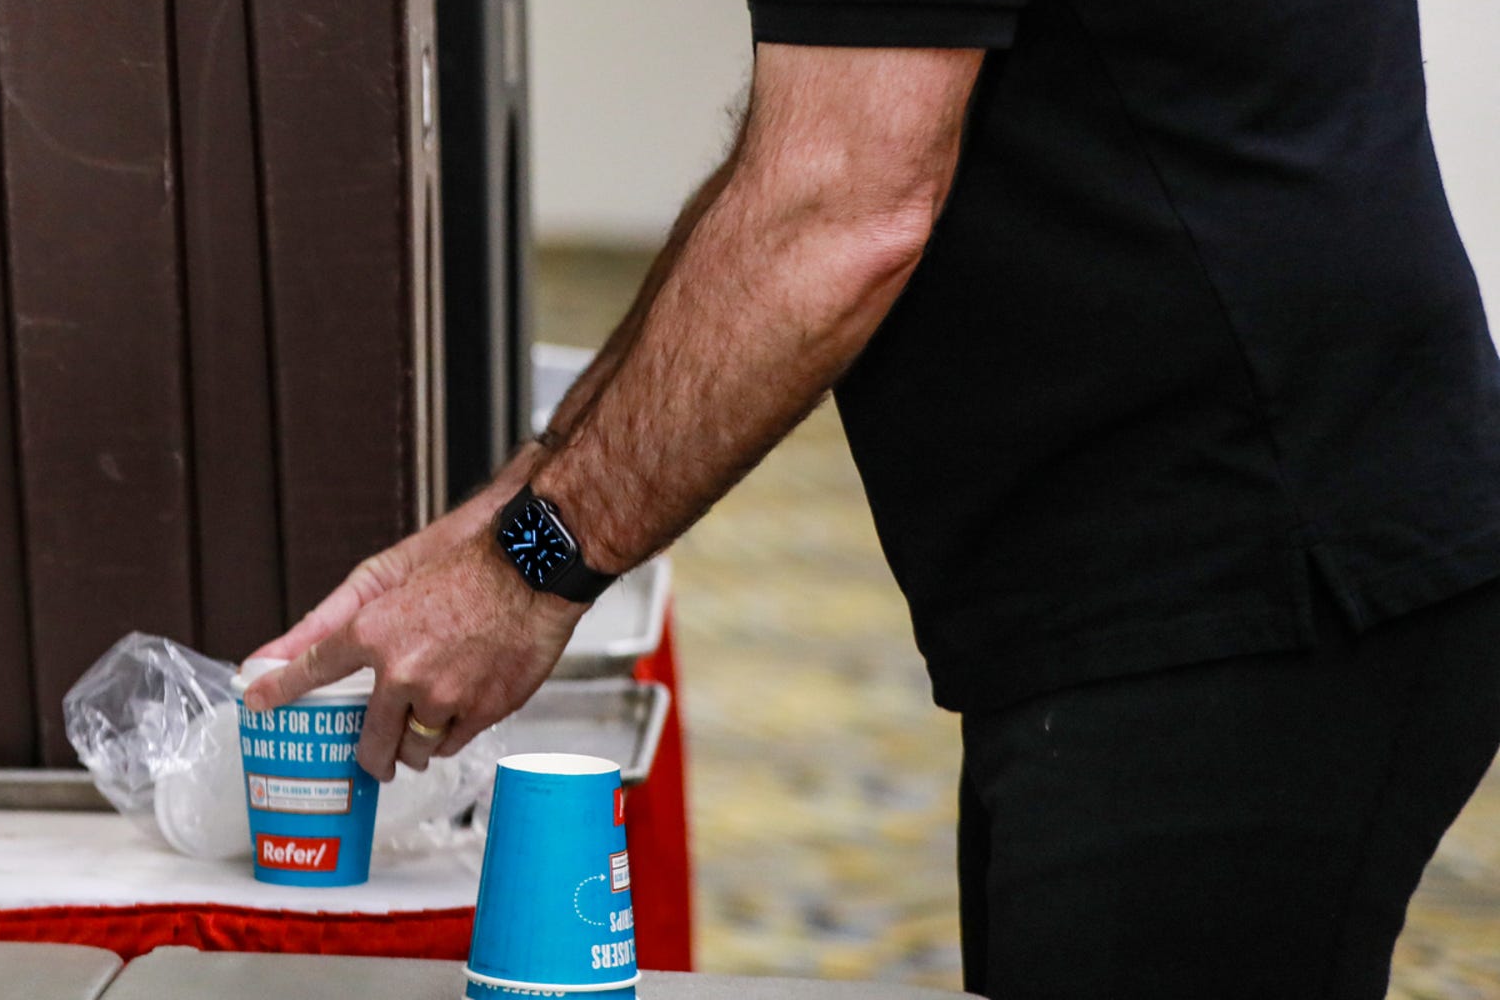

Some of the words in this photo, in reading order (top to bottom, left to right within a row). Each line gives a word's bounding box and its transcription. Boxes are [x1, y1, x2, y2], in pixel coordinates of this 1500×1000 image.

[261, 708, 275, 732] IS
[279, 710, 310, 734] FOR
[254, 738, 276, 760] ARE
[279, 740, 314, 763] FREE
